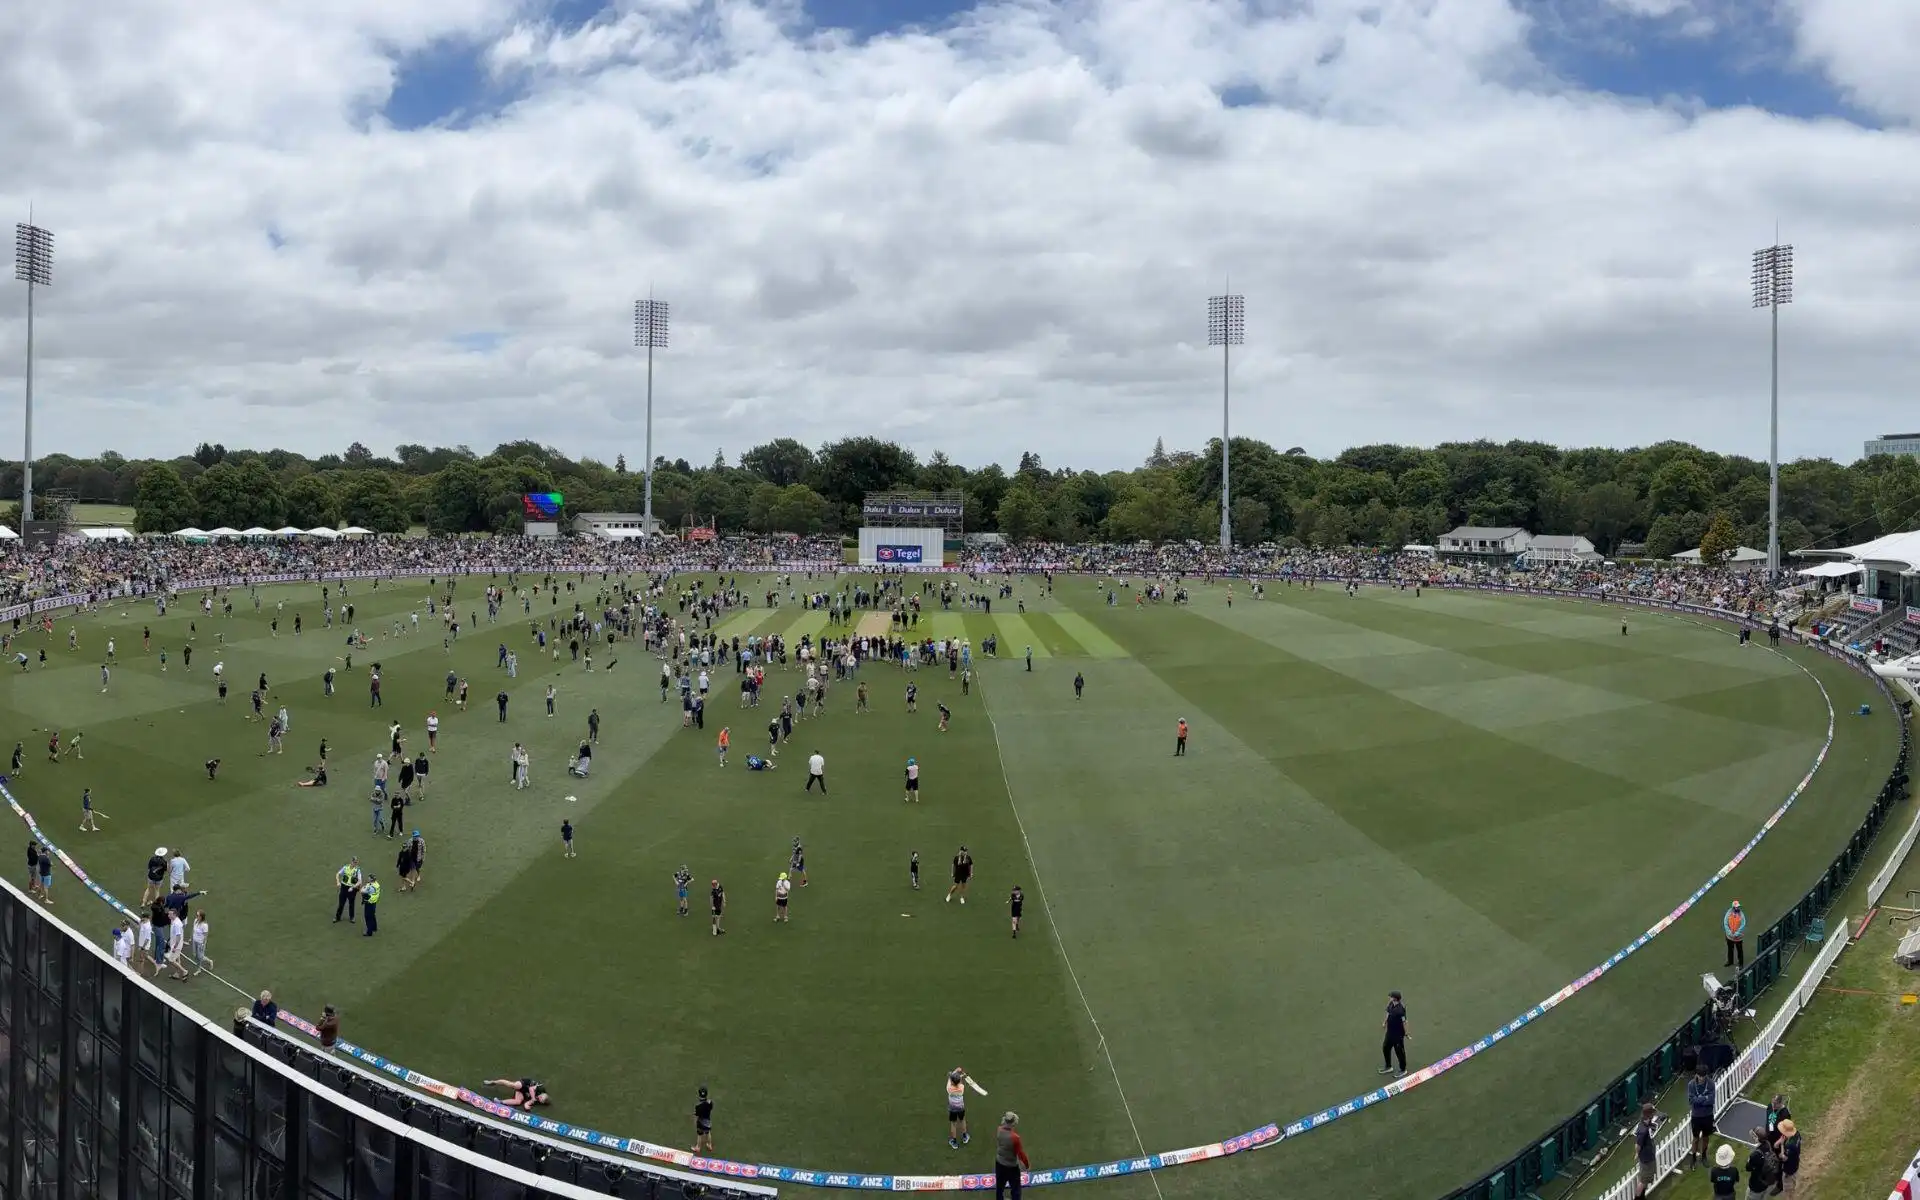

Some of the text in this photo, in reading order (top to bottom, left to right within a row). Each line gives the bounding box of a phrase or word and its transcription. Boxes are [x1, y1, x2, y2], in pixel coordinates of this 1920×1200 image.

[896, 549, 920, 559] Tegel
[338, 1042, 355, 1053] ANZ
[360, 1053, 378, 1064] ANZ
[384, 1064, 402, 1076] ANZ
[1364, 1092, 1380, 1105] ANZ
[1338, 1102, 1355, 1116] ANZ
[511, 1113, 530, 1124] ANZ
[1312, 1112, 1330, 1126] ANZ
[540, 1120, 560, 1132] ANZ
[1286, 1122, 1304, 1136] ANZ
[568, 1128, 588, 1140] ANZ
[598, 1136, 620, 1148] ANZ
[1098, 1164, 1120, 1176] ANZ
[1130, 1158, 1151, 1170] ANZ
[758, 1167, 780, 1178] ANZ
[792, 1172, 814, 1182] ANZ
[1031, 1173, 1053, 1184] ANZ
[1064, 1168, 1087, 1180] ANZ
[826, 1175, 848, 1186] ANZ
[860, 1177, 882, 1187] ANZ
